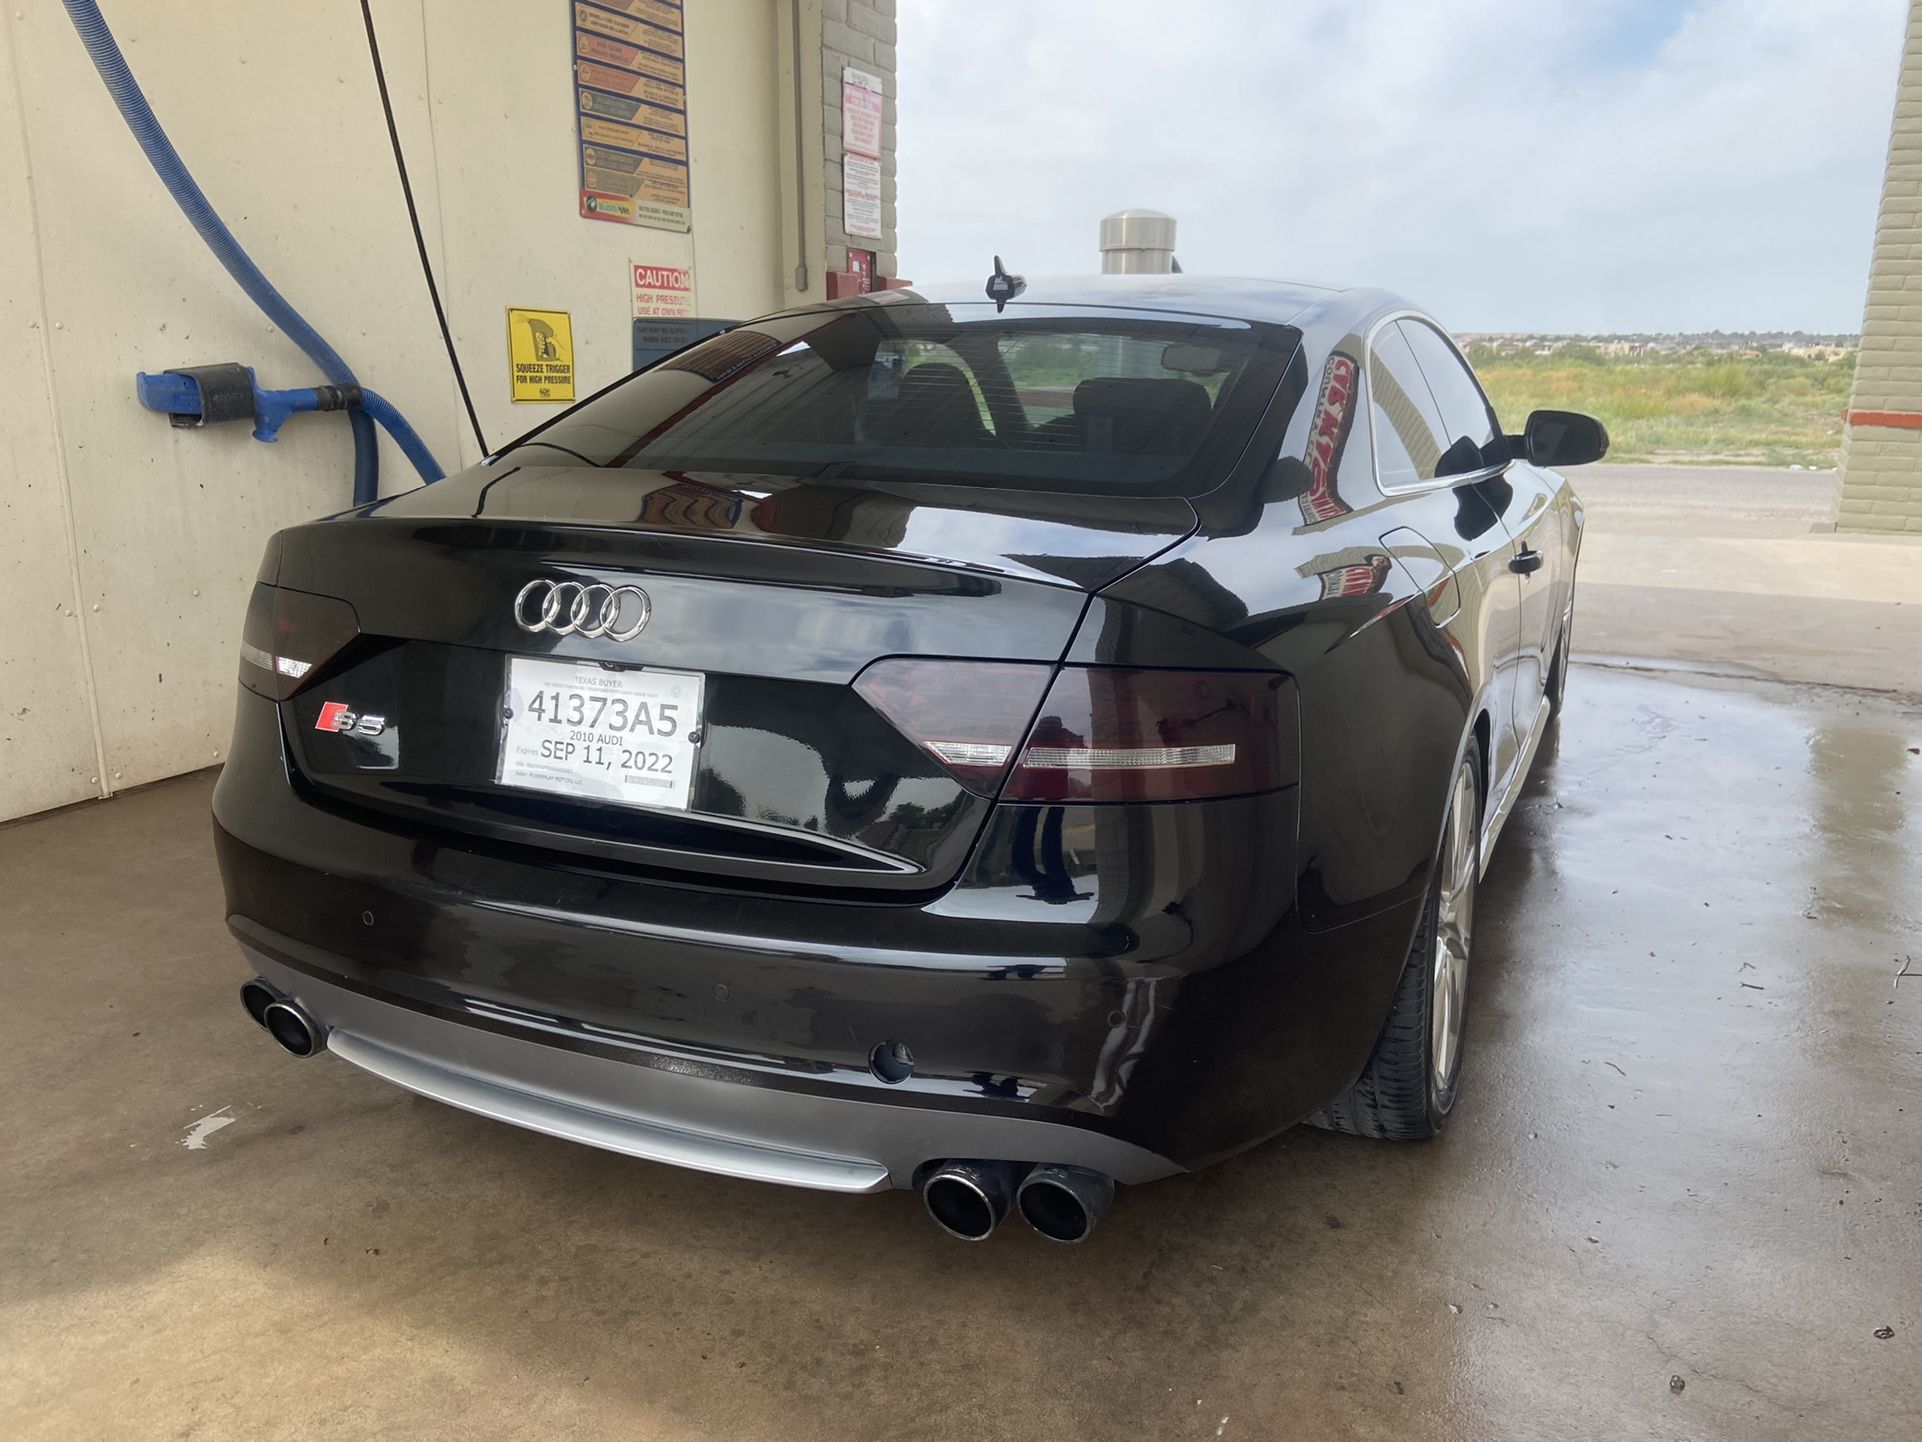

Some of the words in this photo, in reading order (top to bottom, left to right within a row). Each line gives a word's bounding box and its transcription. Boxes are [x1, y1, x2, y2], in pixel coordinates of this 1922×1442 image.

[636, 268, 689, 289] CAUTION
[636, 293, 653, 303] HIGH
[516, 363, 544, 373] SQUEEZE
[545, 364, 571, 374] TRIGGER
[516, 375, 528, 384] FOR
[529, 375, 543, 384] HIGH
[544, 375, 571, 385] PRESSURE
[574, 676, 597, 686] TEXAS
[599, 678, 623, 688] BUYER
[528, 690, 679, 738] 41373A5
[570, 730, 594, 743] 2010
[597, 733, 623, 746] AUDI
[540, 739, 576, 761] SEP
[583, 744, 612, 771] 11,
[620, 749, 674, 774] 2022
